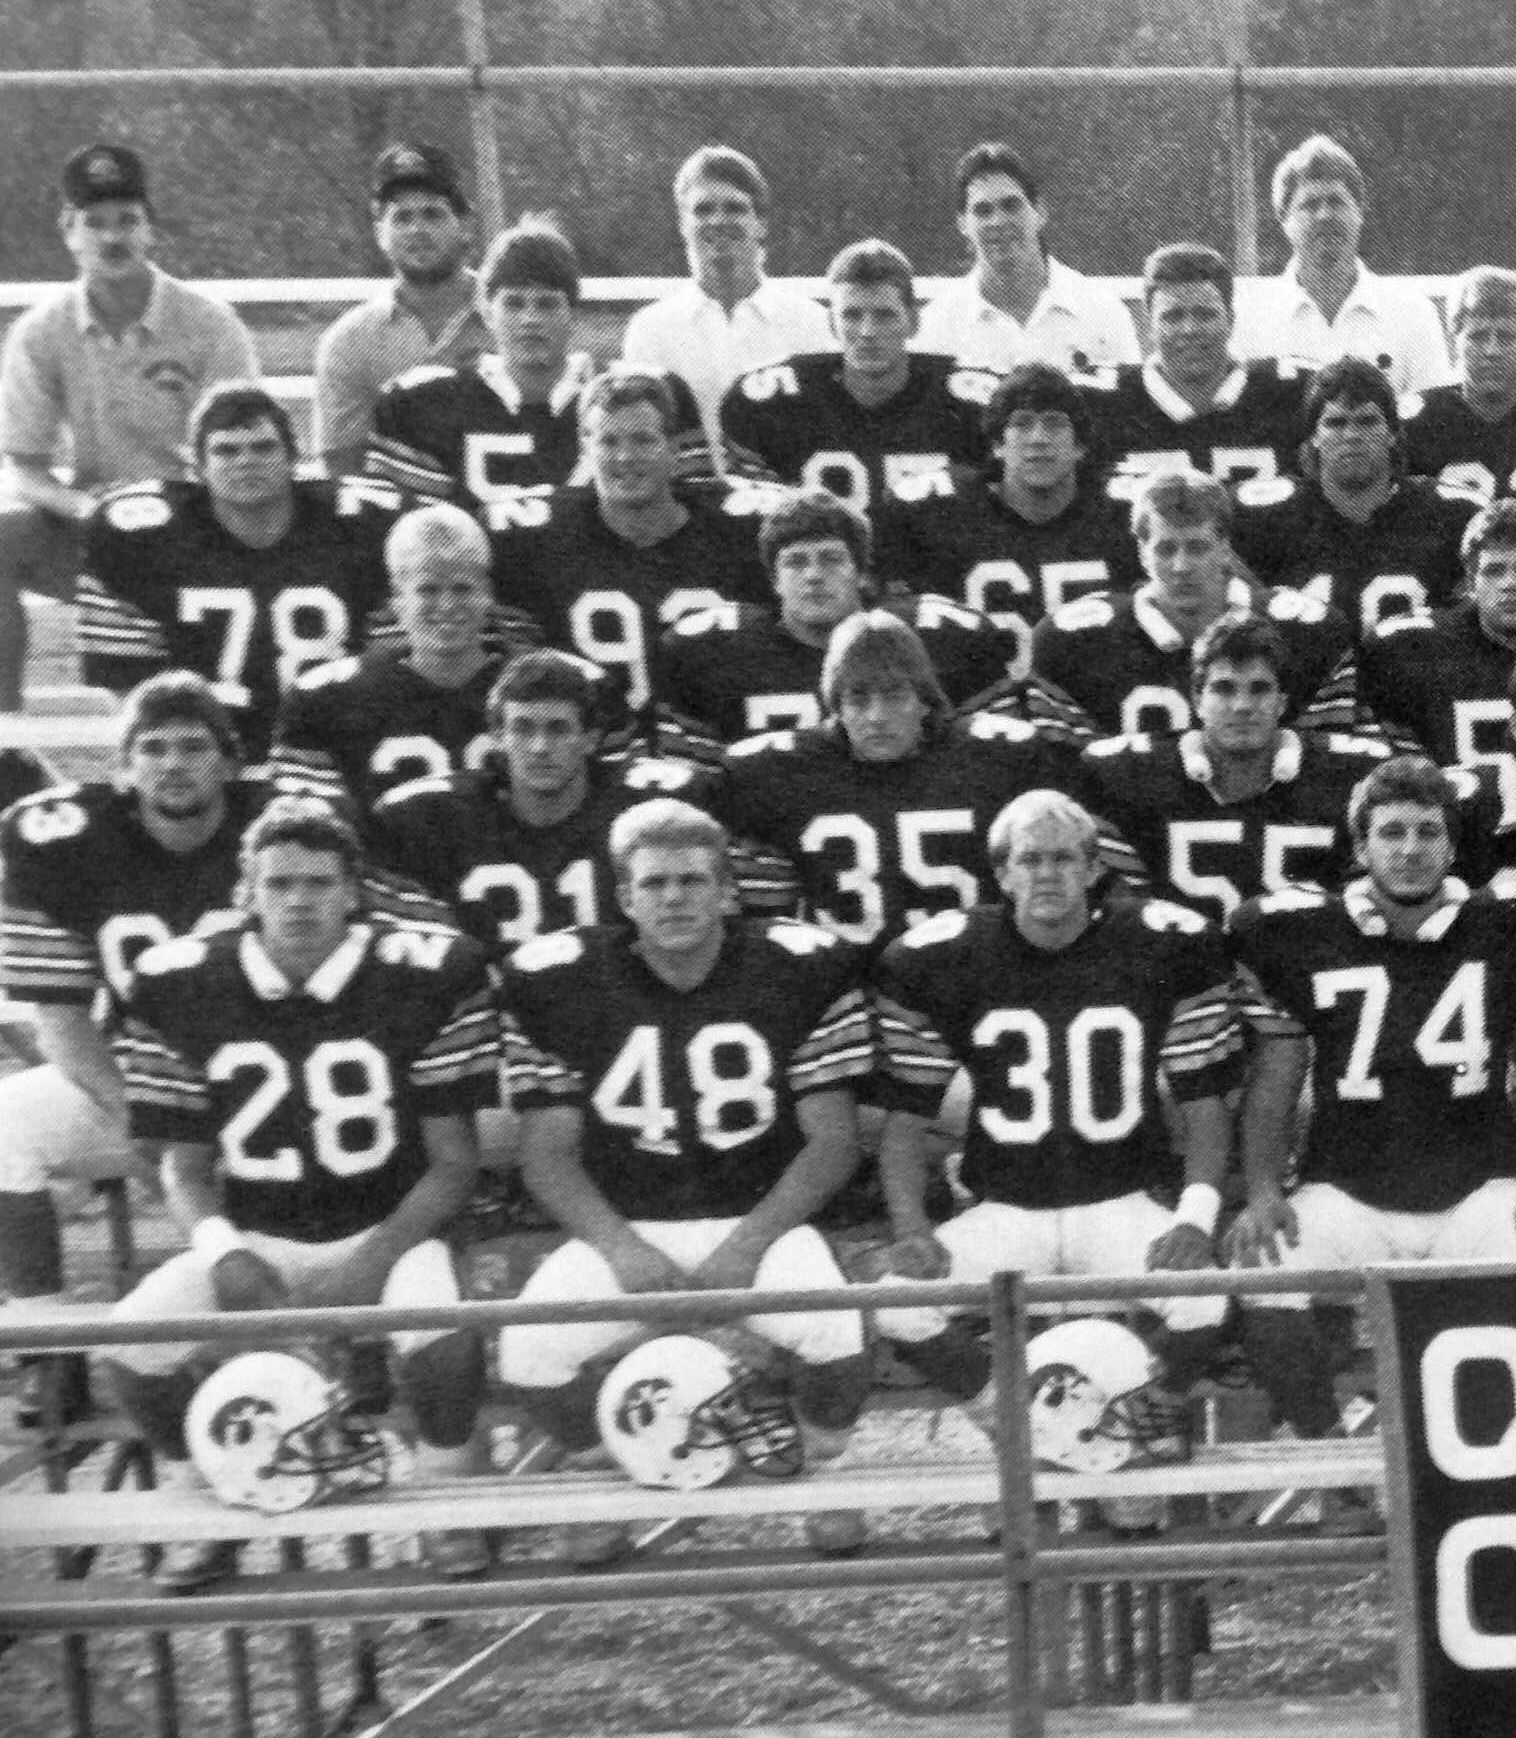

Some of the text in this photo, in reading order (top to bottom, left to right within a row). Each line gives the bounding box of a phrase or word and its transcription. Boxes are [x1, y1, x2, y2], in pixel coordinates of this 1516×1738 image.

[178, 586, 350, 704] 78
[800, 809, 978, 944] 35
[1167, 820, 1335, 930] 55
[592, 1023, 776, 1156] 48
[972, 1006, 1144, 1143] 30
[1312, 962, 1490, 1099] 74
[207, 1038, 396, 1181] 28
